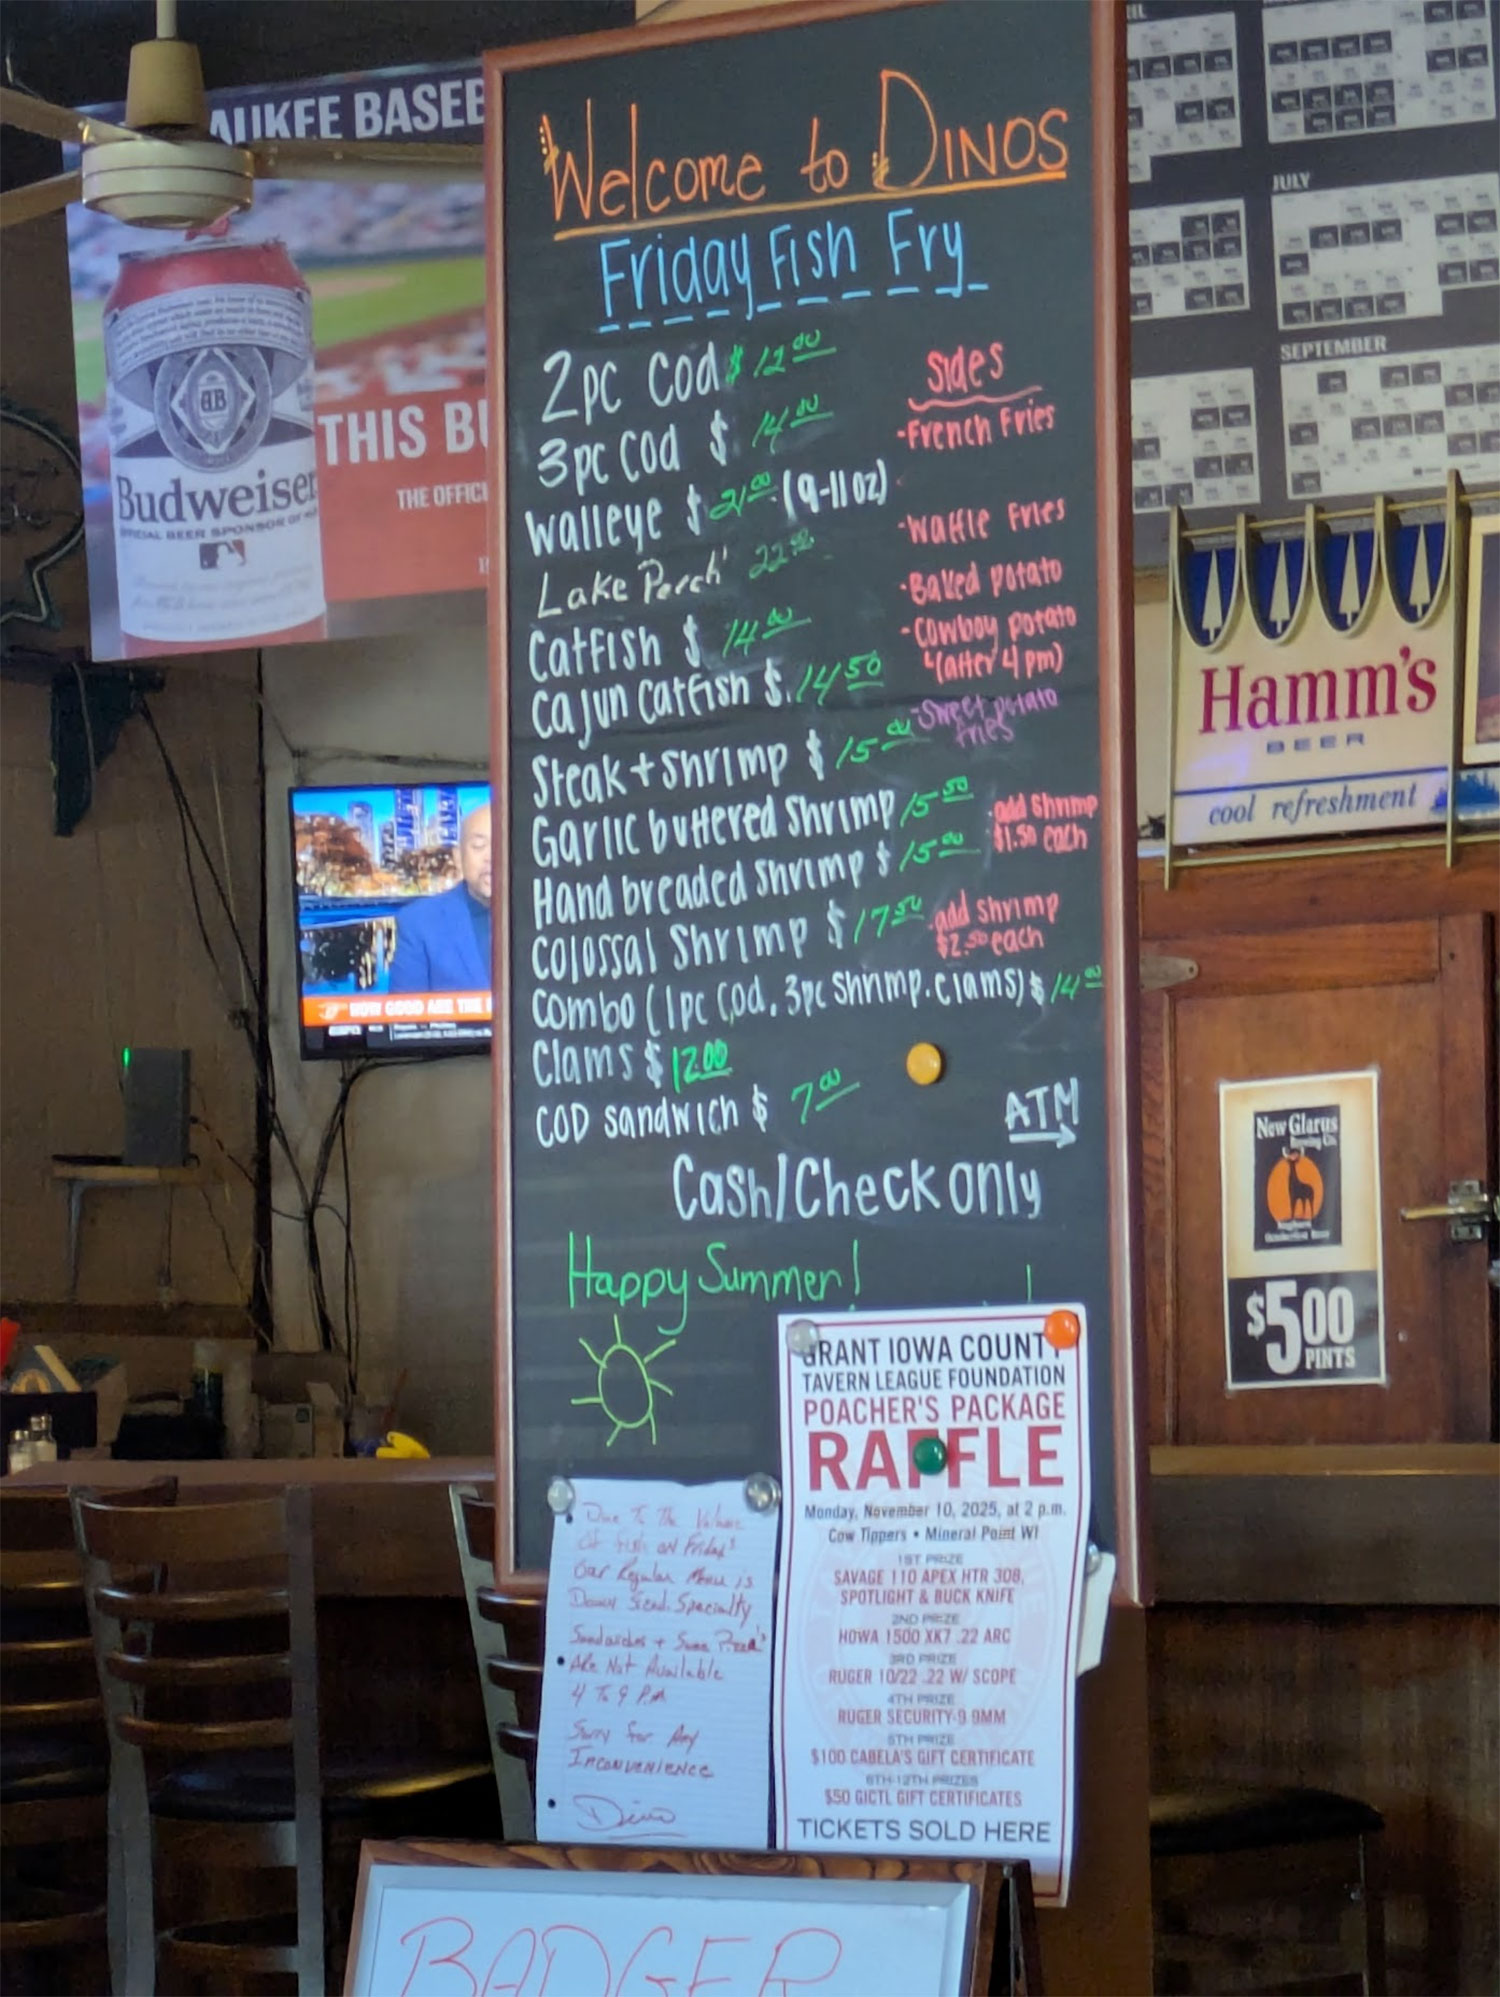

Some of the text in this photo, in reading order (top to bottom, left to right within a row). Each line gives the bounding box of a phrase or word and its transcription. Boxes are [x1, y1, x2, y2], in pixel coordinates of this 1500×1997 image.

[541, 98, 765, 221] Welcome
[801, 117, 849, 193] to
[1272, 171, 1311, 192] JULY
[600, 207, 965, 320] Friday Fish Fry
[1280, 335, 1388, 361] SEPTEMBER
[317, 405, 428, 466] THIS
[116, 468, 318, 523] Budweiser
[396, 487, 430, 510] THE
[537, 571, 629, 619] Lake
[1199, 644, 1437, 735] Hamm's
[1209, 782, 1417, 827] cool refreshment
[532, 814, 641, 868] Garlic
[533, 875, 614, 930] Hand
[1004, 1077, 1080, 1131] ATM
[1256, 1111, 1338, 1139] New Glarus
[568, 1230, 688, 1336] Happy
[889, 1335, 953, 1364] IOWA
[961, 1332, 1061, 1362] COUNT
[1305, 1346, 1356, 1371] PINTS
[802, 1364, 1065, 1393] TAVERN LEAGUE FOUNDATION
[804, 1391, 1065, 1426] POACHER'S PACKAGE
[804, 1504, 858, 1520] Monday,
[864, 1503, 929, 1518] November
[1007, 1502, 1020, 1516] at
[1024, 1501, 1033, 1516] 2
[1037, 1502, 1067, 1520] p.m.
[828, 1525, 1039, 1544] Cow Tippers Mineral Point WI
[834, 1569, 885, 1586] SAVAGE
[891, 1569, 917, 1585] 110
[922, 1568, 956, 1585] APEX
[961, 1567, 988, 1583] HTR
[840, 1587, 1015, 1605] SPOTLIGHT & BUCK KNIFE
[838, 1629, 879, 1645] HOWA
[886, 1628, 920, 1645] 1500
[983, 1627, 1011, 1644] ARC
[828, 1668, 872, 1685] RUGER
[879, 1668, 917, 1685] 10/22
[949, 1667, 969, 1685] W/
[973, 1668, 1016, 1685] SCOPE
[837, 1708, 1006, 1725] RUGER SECURITY-9 9MM
[811, 1748, 1035, 1767] $100 CABELA'S GIFT CERTIFICATE
[824, 1788, 850, 1806] $50
[896, 1789, 925, 1806] GIFT
[929, 1789, 1022, 1807] CERTIFICATES
[797, 1818, 1052, 1843] TICKETS SOLD HERE
